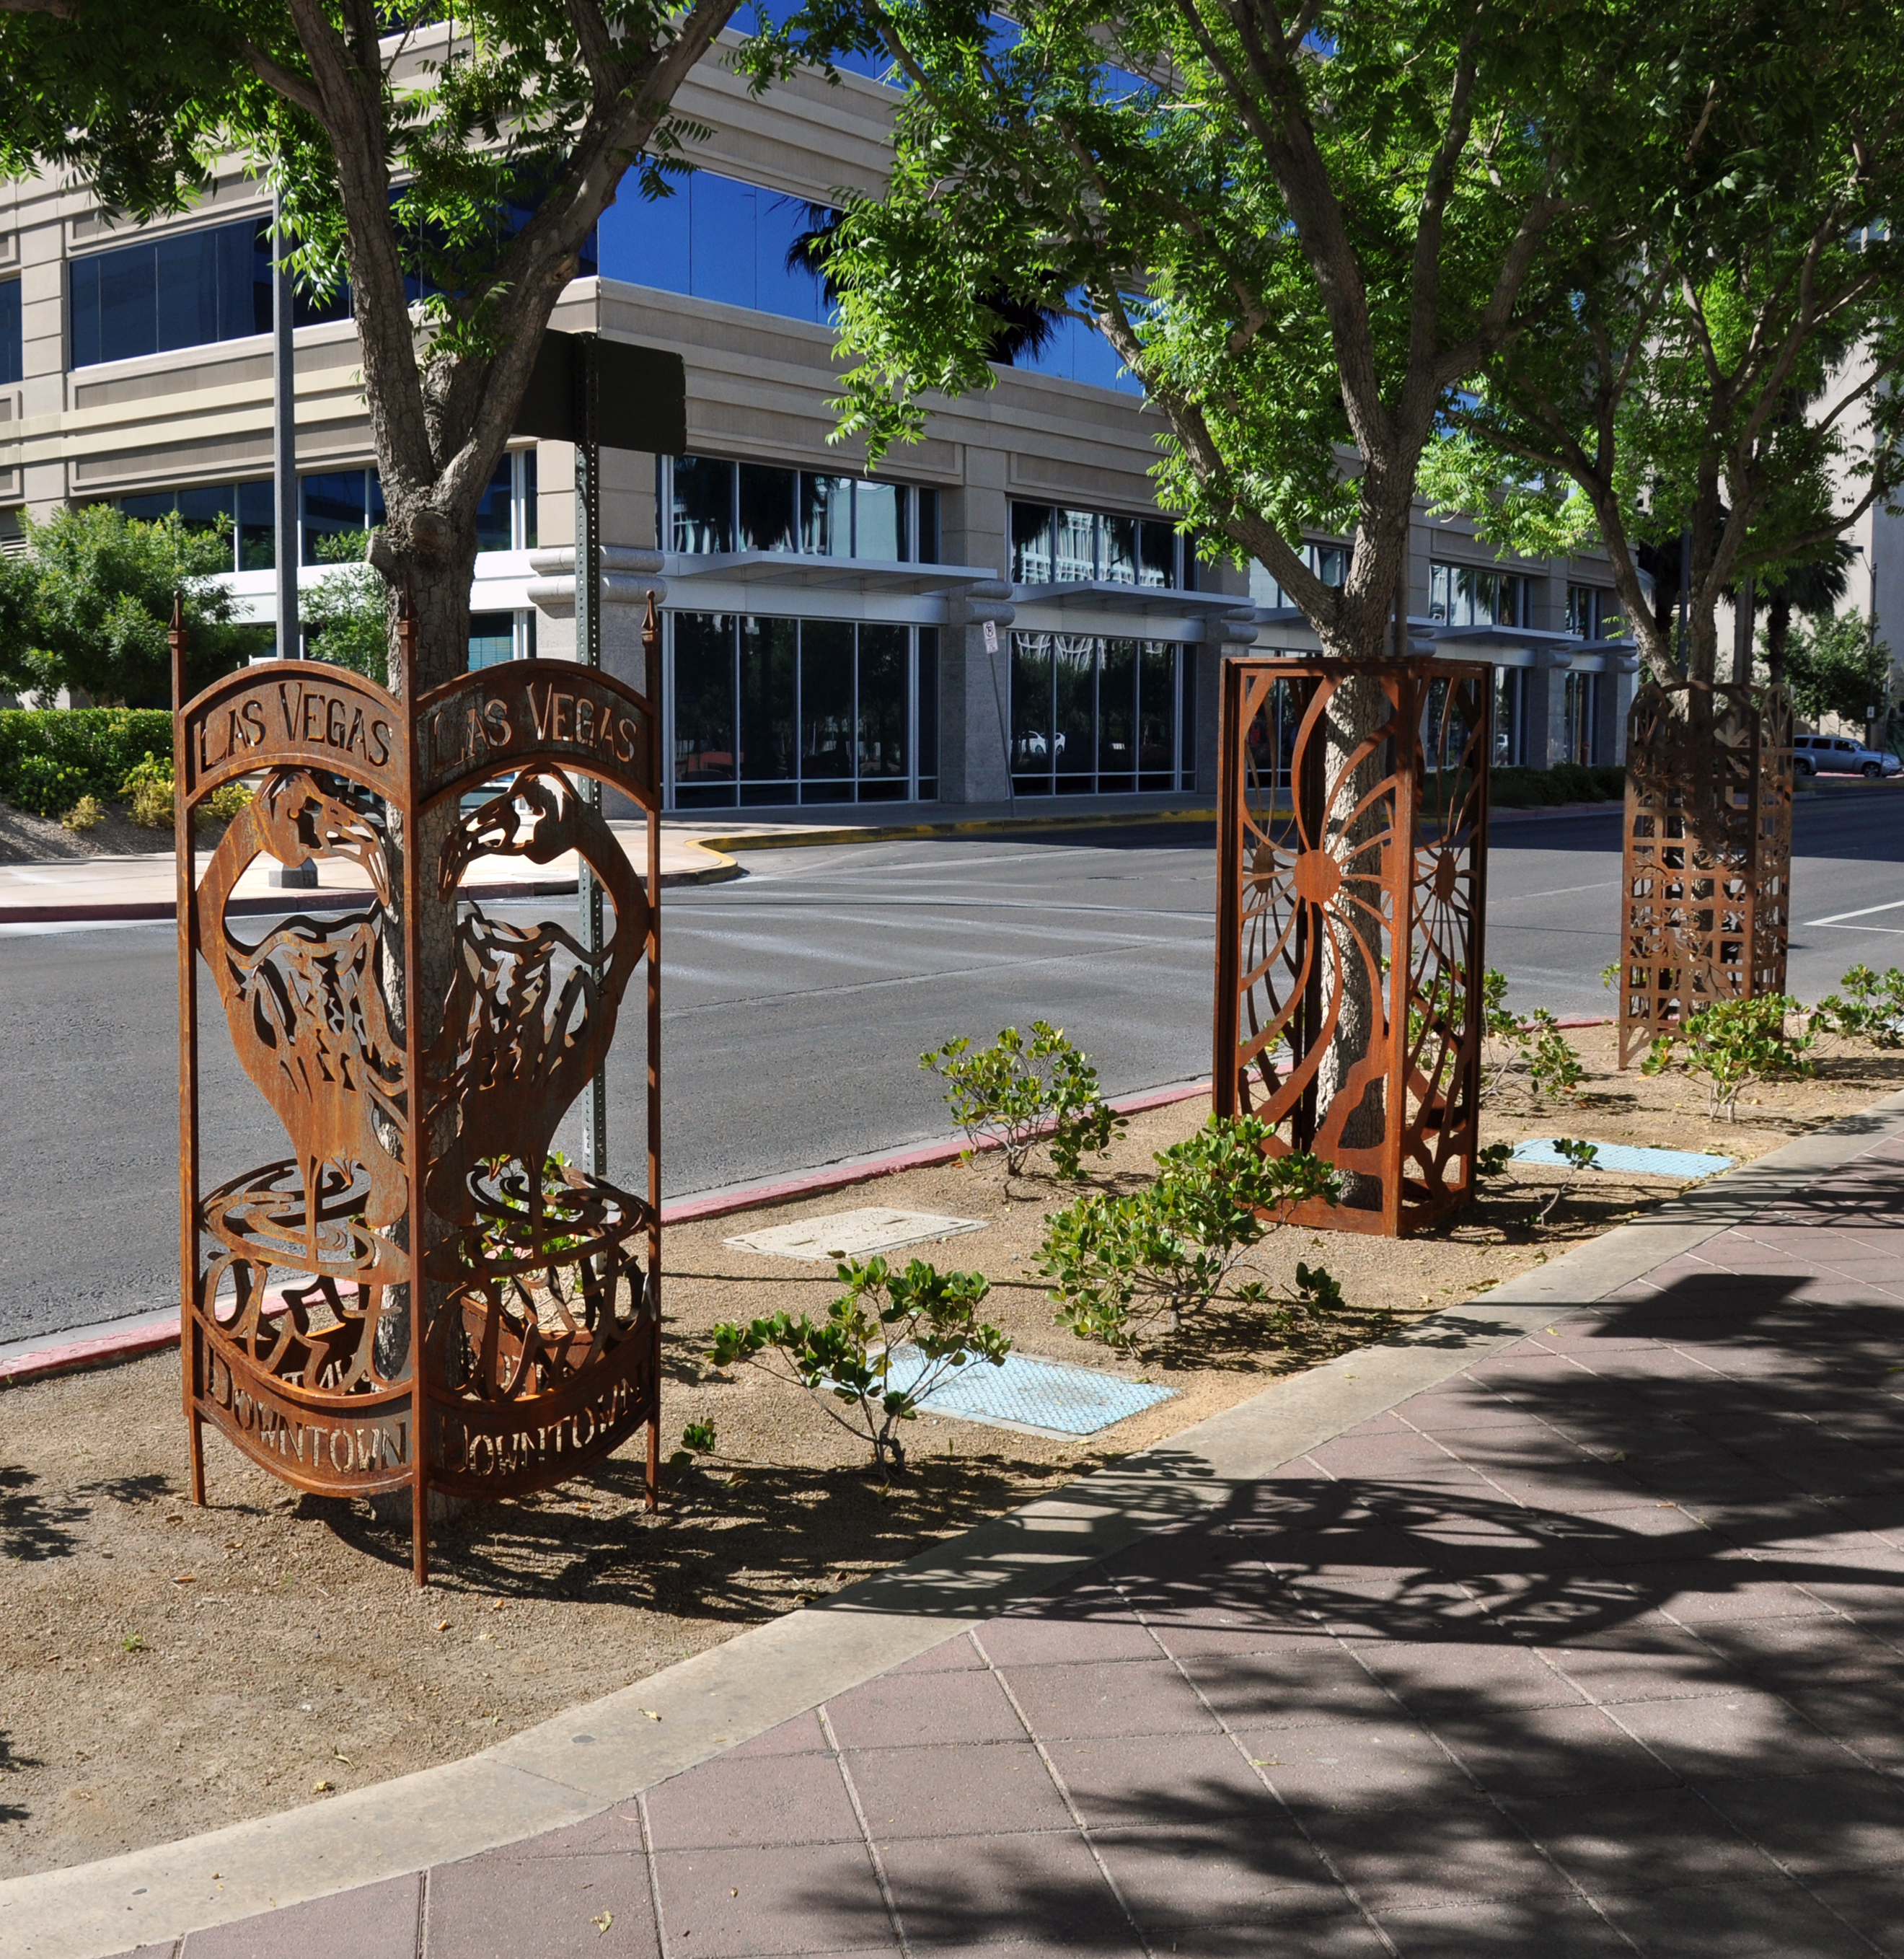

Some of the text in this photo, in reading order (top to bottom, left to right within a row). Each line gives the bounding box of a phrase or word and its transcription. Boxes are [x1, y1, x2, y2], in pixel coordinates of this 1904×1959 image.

[194, 682, 392, 774] LAS VEGAS
[431, 682, 638, 777] LAS VEGAS
[206, 1341, 406, 1473] DOWNTOWN
